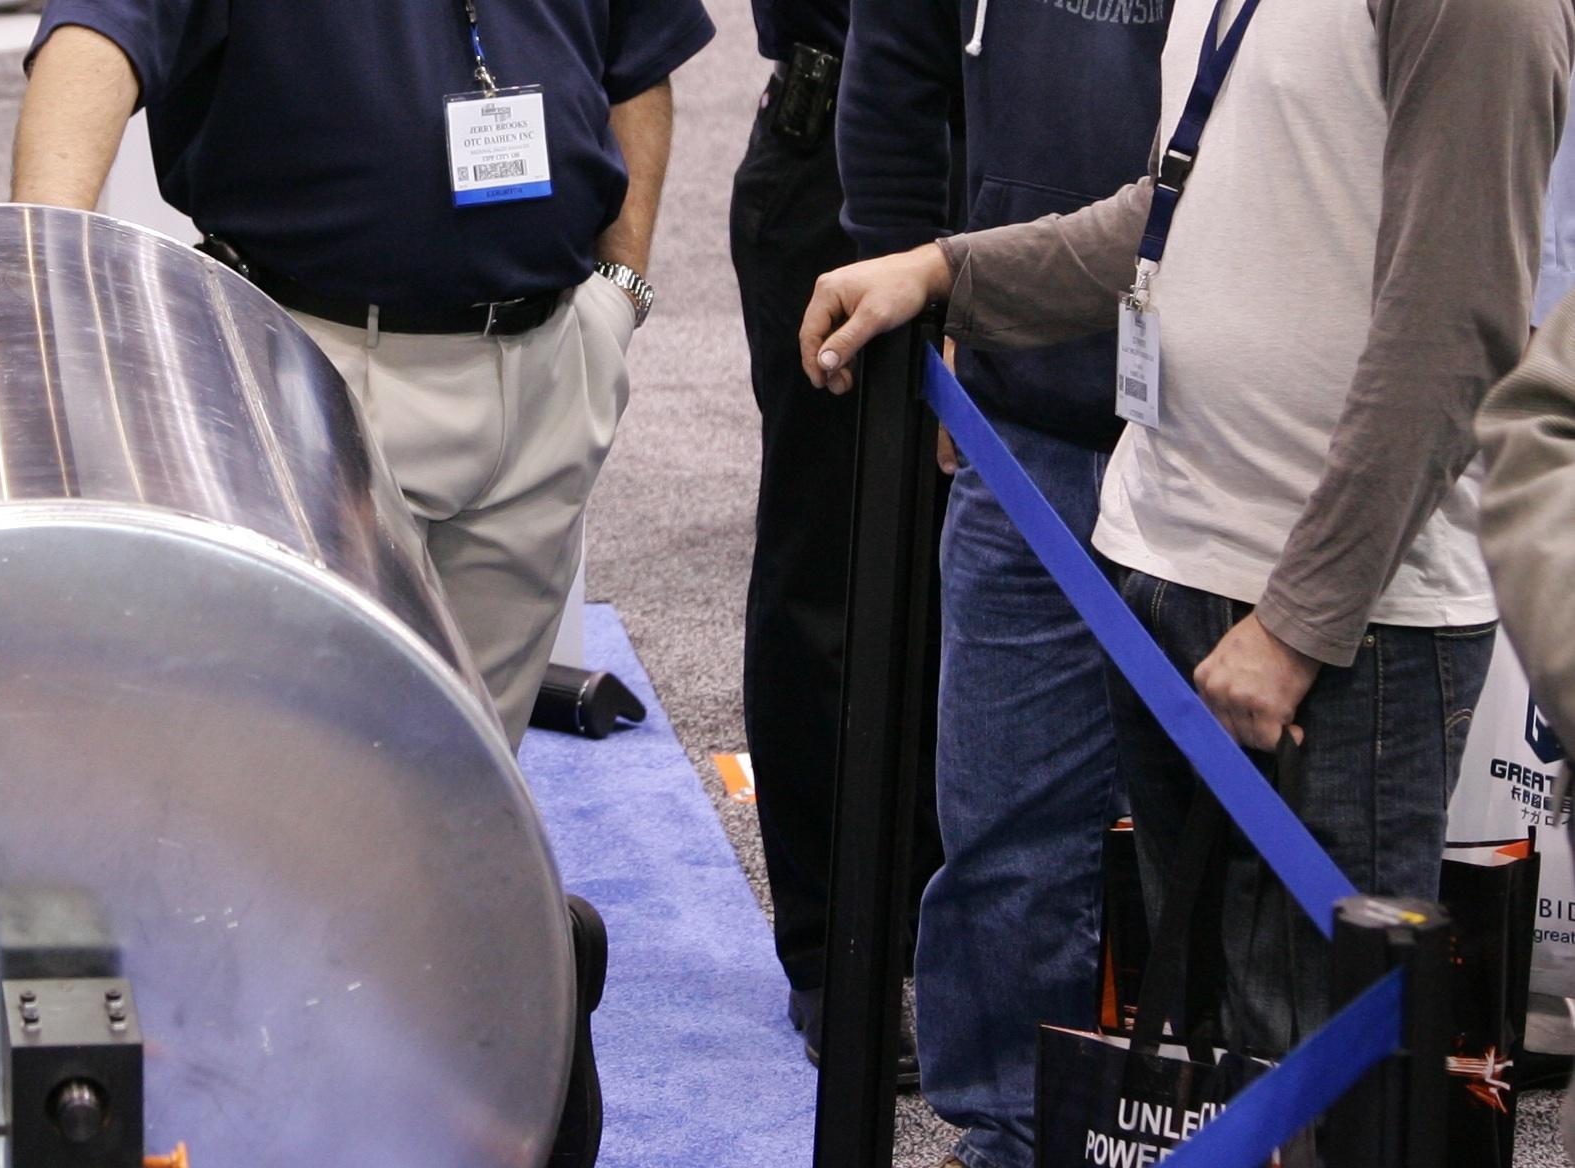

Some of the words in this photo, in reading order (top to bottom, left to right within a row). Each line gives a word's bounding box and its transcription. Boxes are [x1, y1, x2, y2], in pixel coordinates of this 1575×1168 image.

[464, 137, 482, 148] OTC
[484, 133, 518, 145] DAIHEN
[519, 131, 535, 141] INC
[1085, 1129, 1176, 1168] POWE
